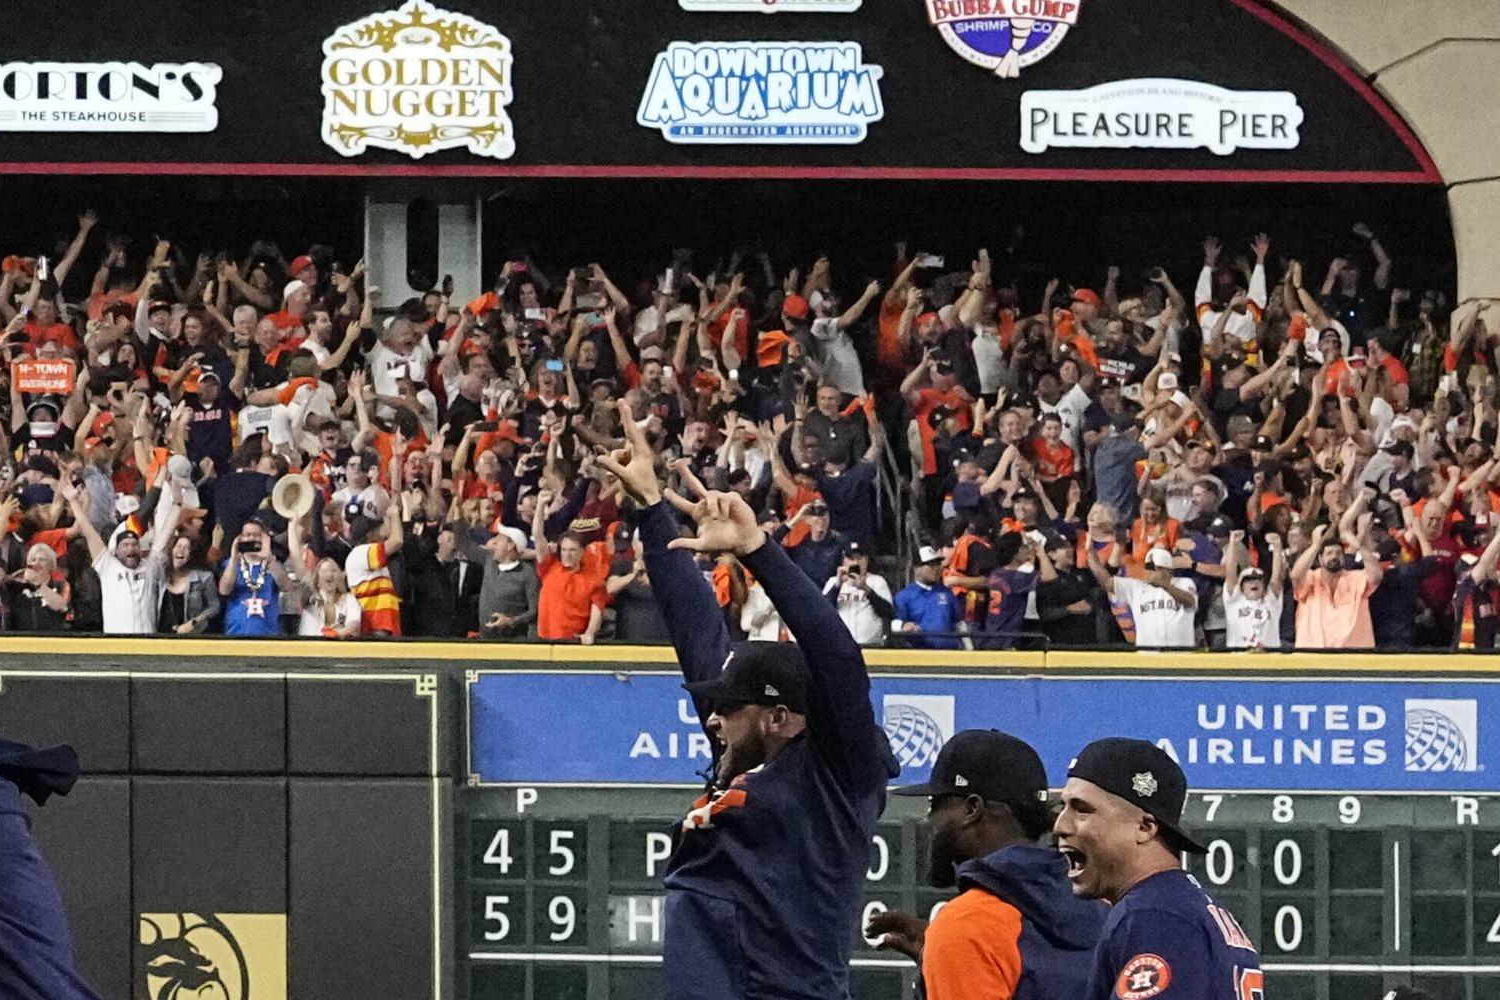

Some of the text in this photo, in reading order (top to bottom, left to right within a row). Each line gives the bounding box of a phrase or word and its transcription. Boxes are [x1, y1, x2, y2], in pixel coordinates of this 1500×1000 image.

[1011, 0, 1076, 19] GUMP
[954, 20, 1053, 34] SHRIMP CO
[328, 57, 506, 88] GOLDEN
[672, 46, 858, 79] DOWNTOWN
[330, 88, 506, 119] NUGGET
[643, 56, 879, 124] AQUARIUM
[21, 110, 148, 122] THE STEAKHOUSE
[1030, 107, 1290, 145] PLEASURE PIER
[1198, 703, 1388, 731] UNITED
[516, 788, 538, 814] P
[1202, 795, 1361, 824] 7 8 9
[1455, 797, 1480, 826] R
[1205, 839, 1234, 885] 0
[1273, 839, 1302, 885] 0
[1274, 905, 1303, 951] 0
